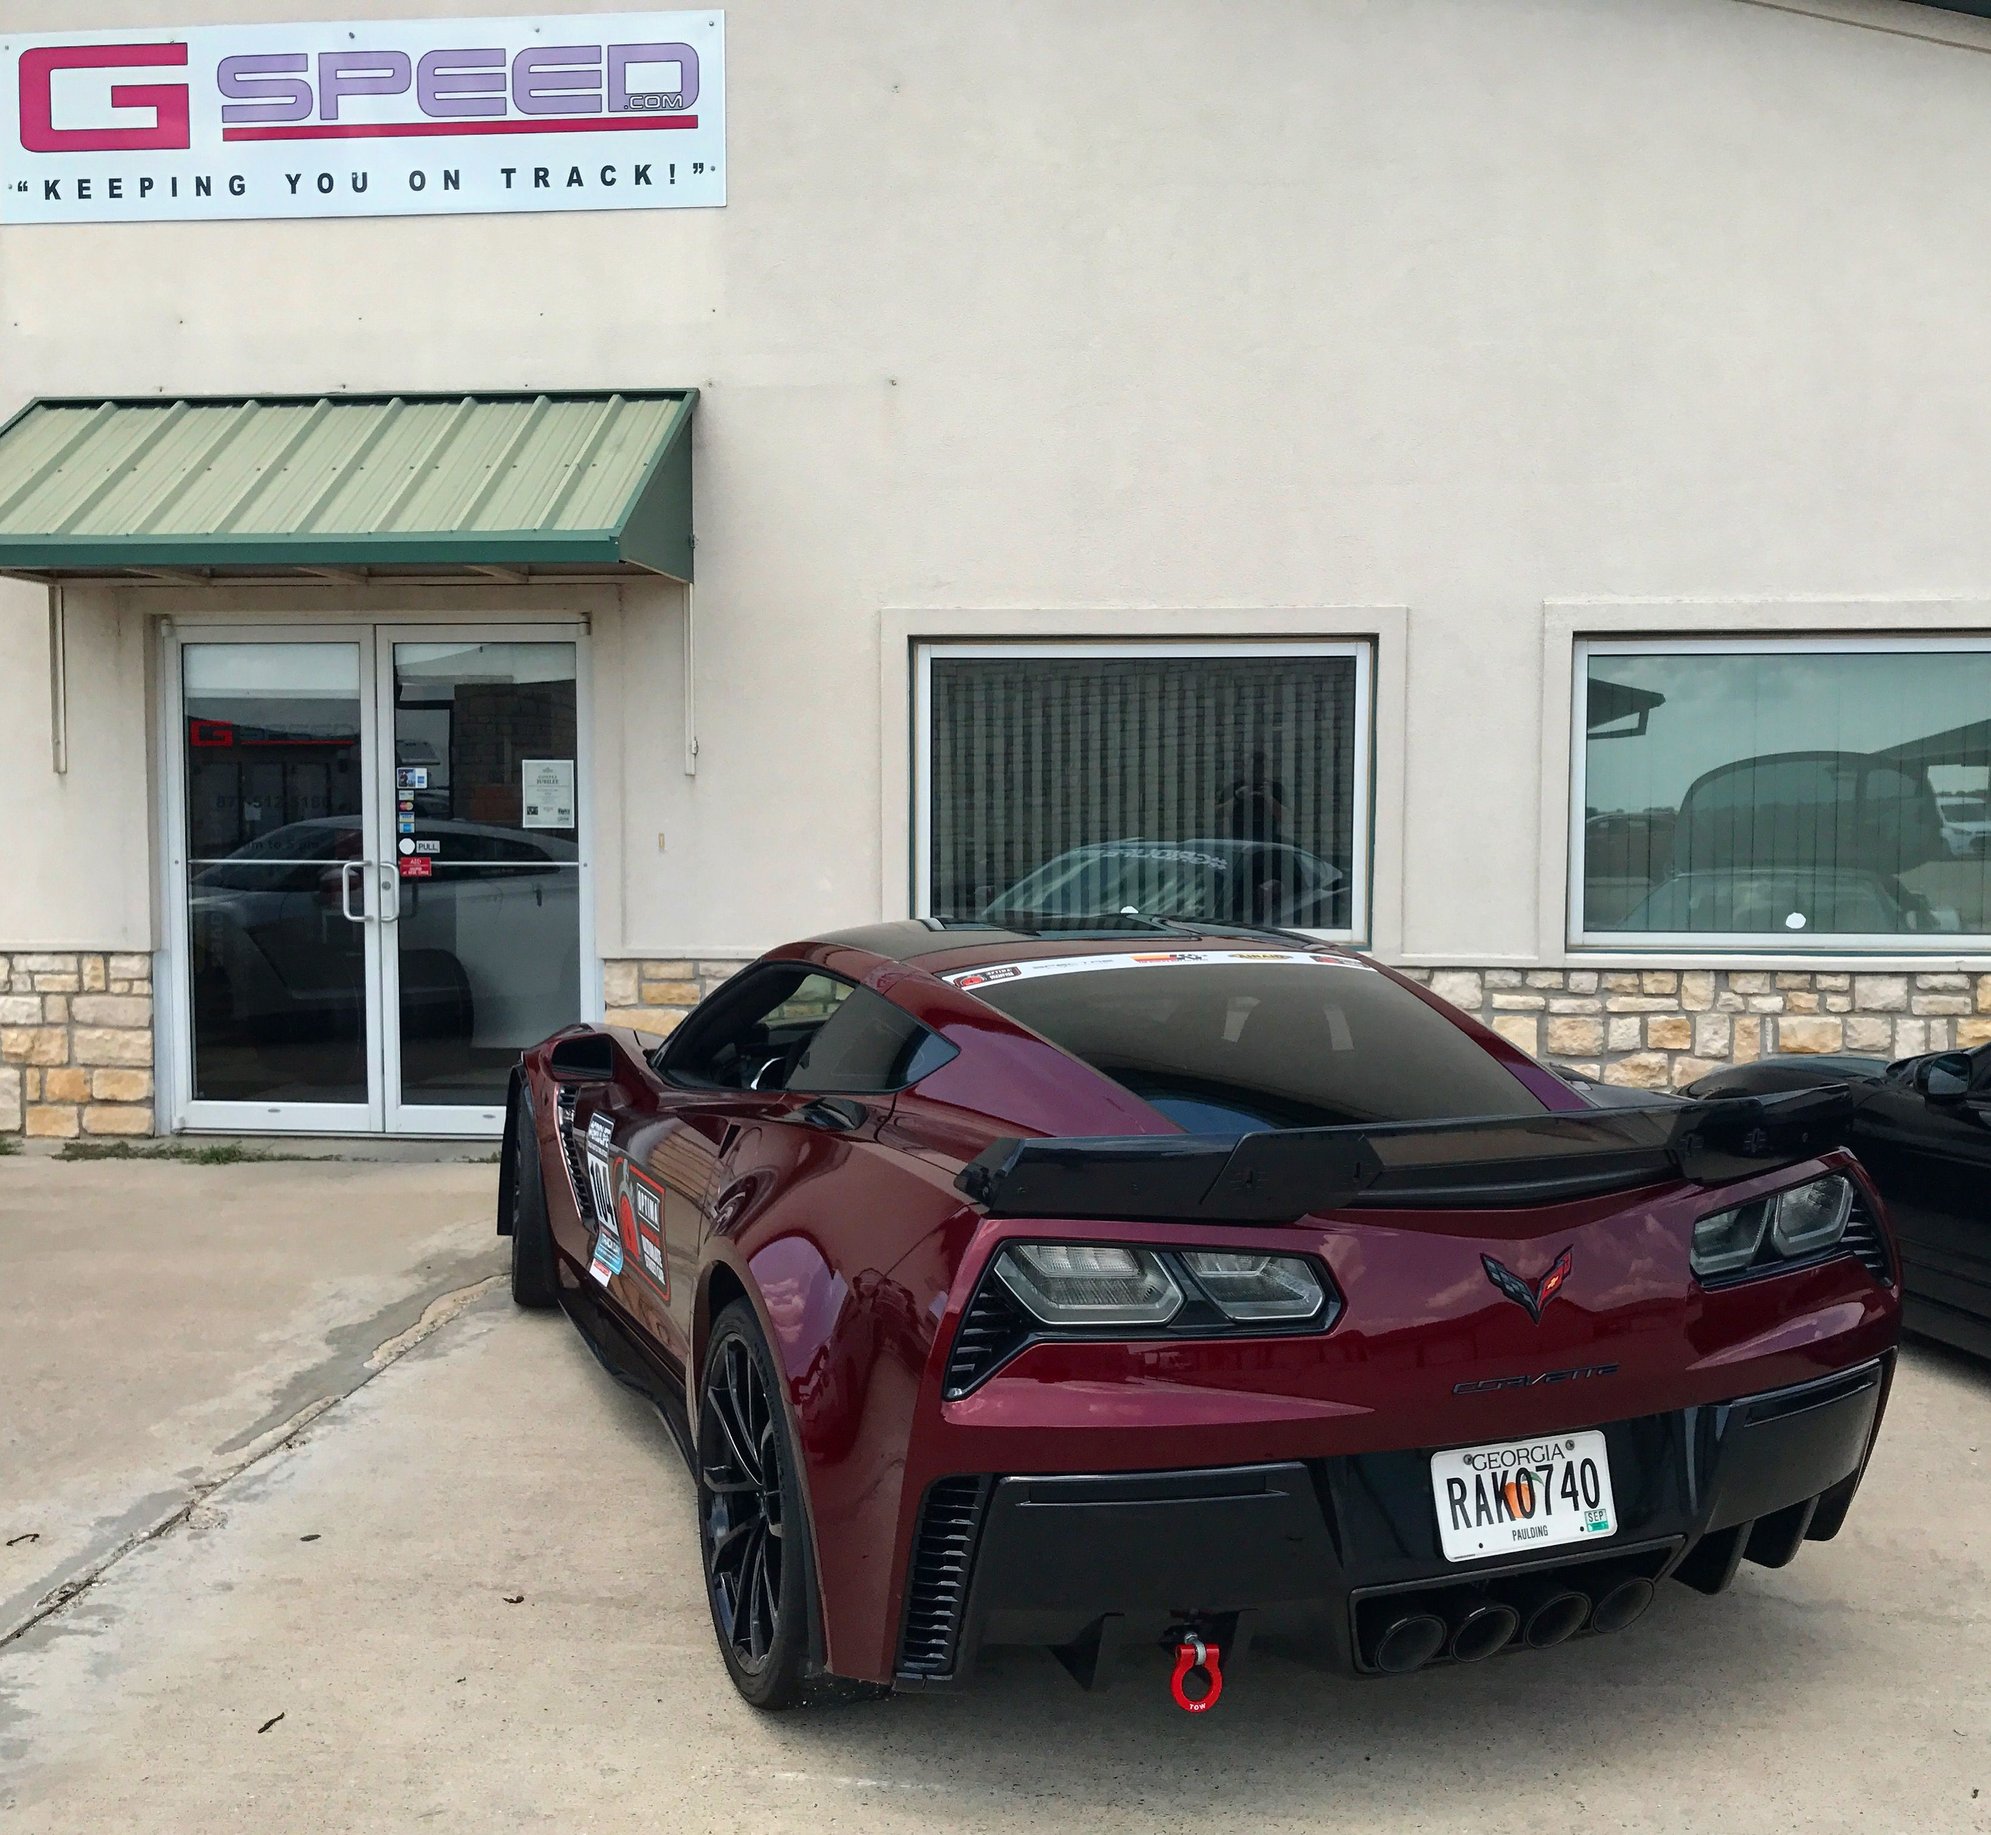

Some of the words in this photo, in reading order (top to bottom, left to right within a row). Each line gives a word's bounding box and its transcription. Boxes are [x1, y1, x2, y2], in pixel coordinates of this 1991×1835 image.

[19, 41, 190, 153] G
[217, 42, 700, 123] SPEED
[624, 93, 684, 110] .COM
[285, 172, 368, 195] YOU
[409, 169, 460, 192] ON
[500, 162, 704, 189] TRACK!”
[191, 721, 232, 747] G
[418, 843, 438, 851] PULL
[590, 1159, 616, 1227] 104
[1452, 1363, 1620, 1395] CORVETTE
[1471, 1443, 1566, 1472] GEORGIA
[1587, 1510, 1604, 1522] SEP
[1512, 1525, 1549, 1542] PAULDING
[1189, 1703, 1206, 1711] TOW
